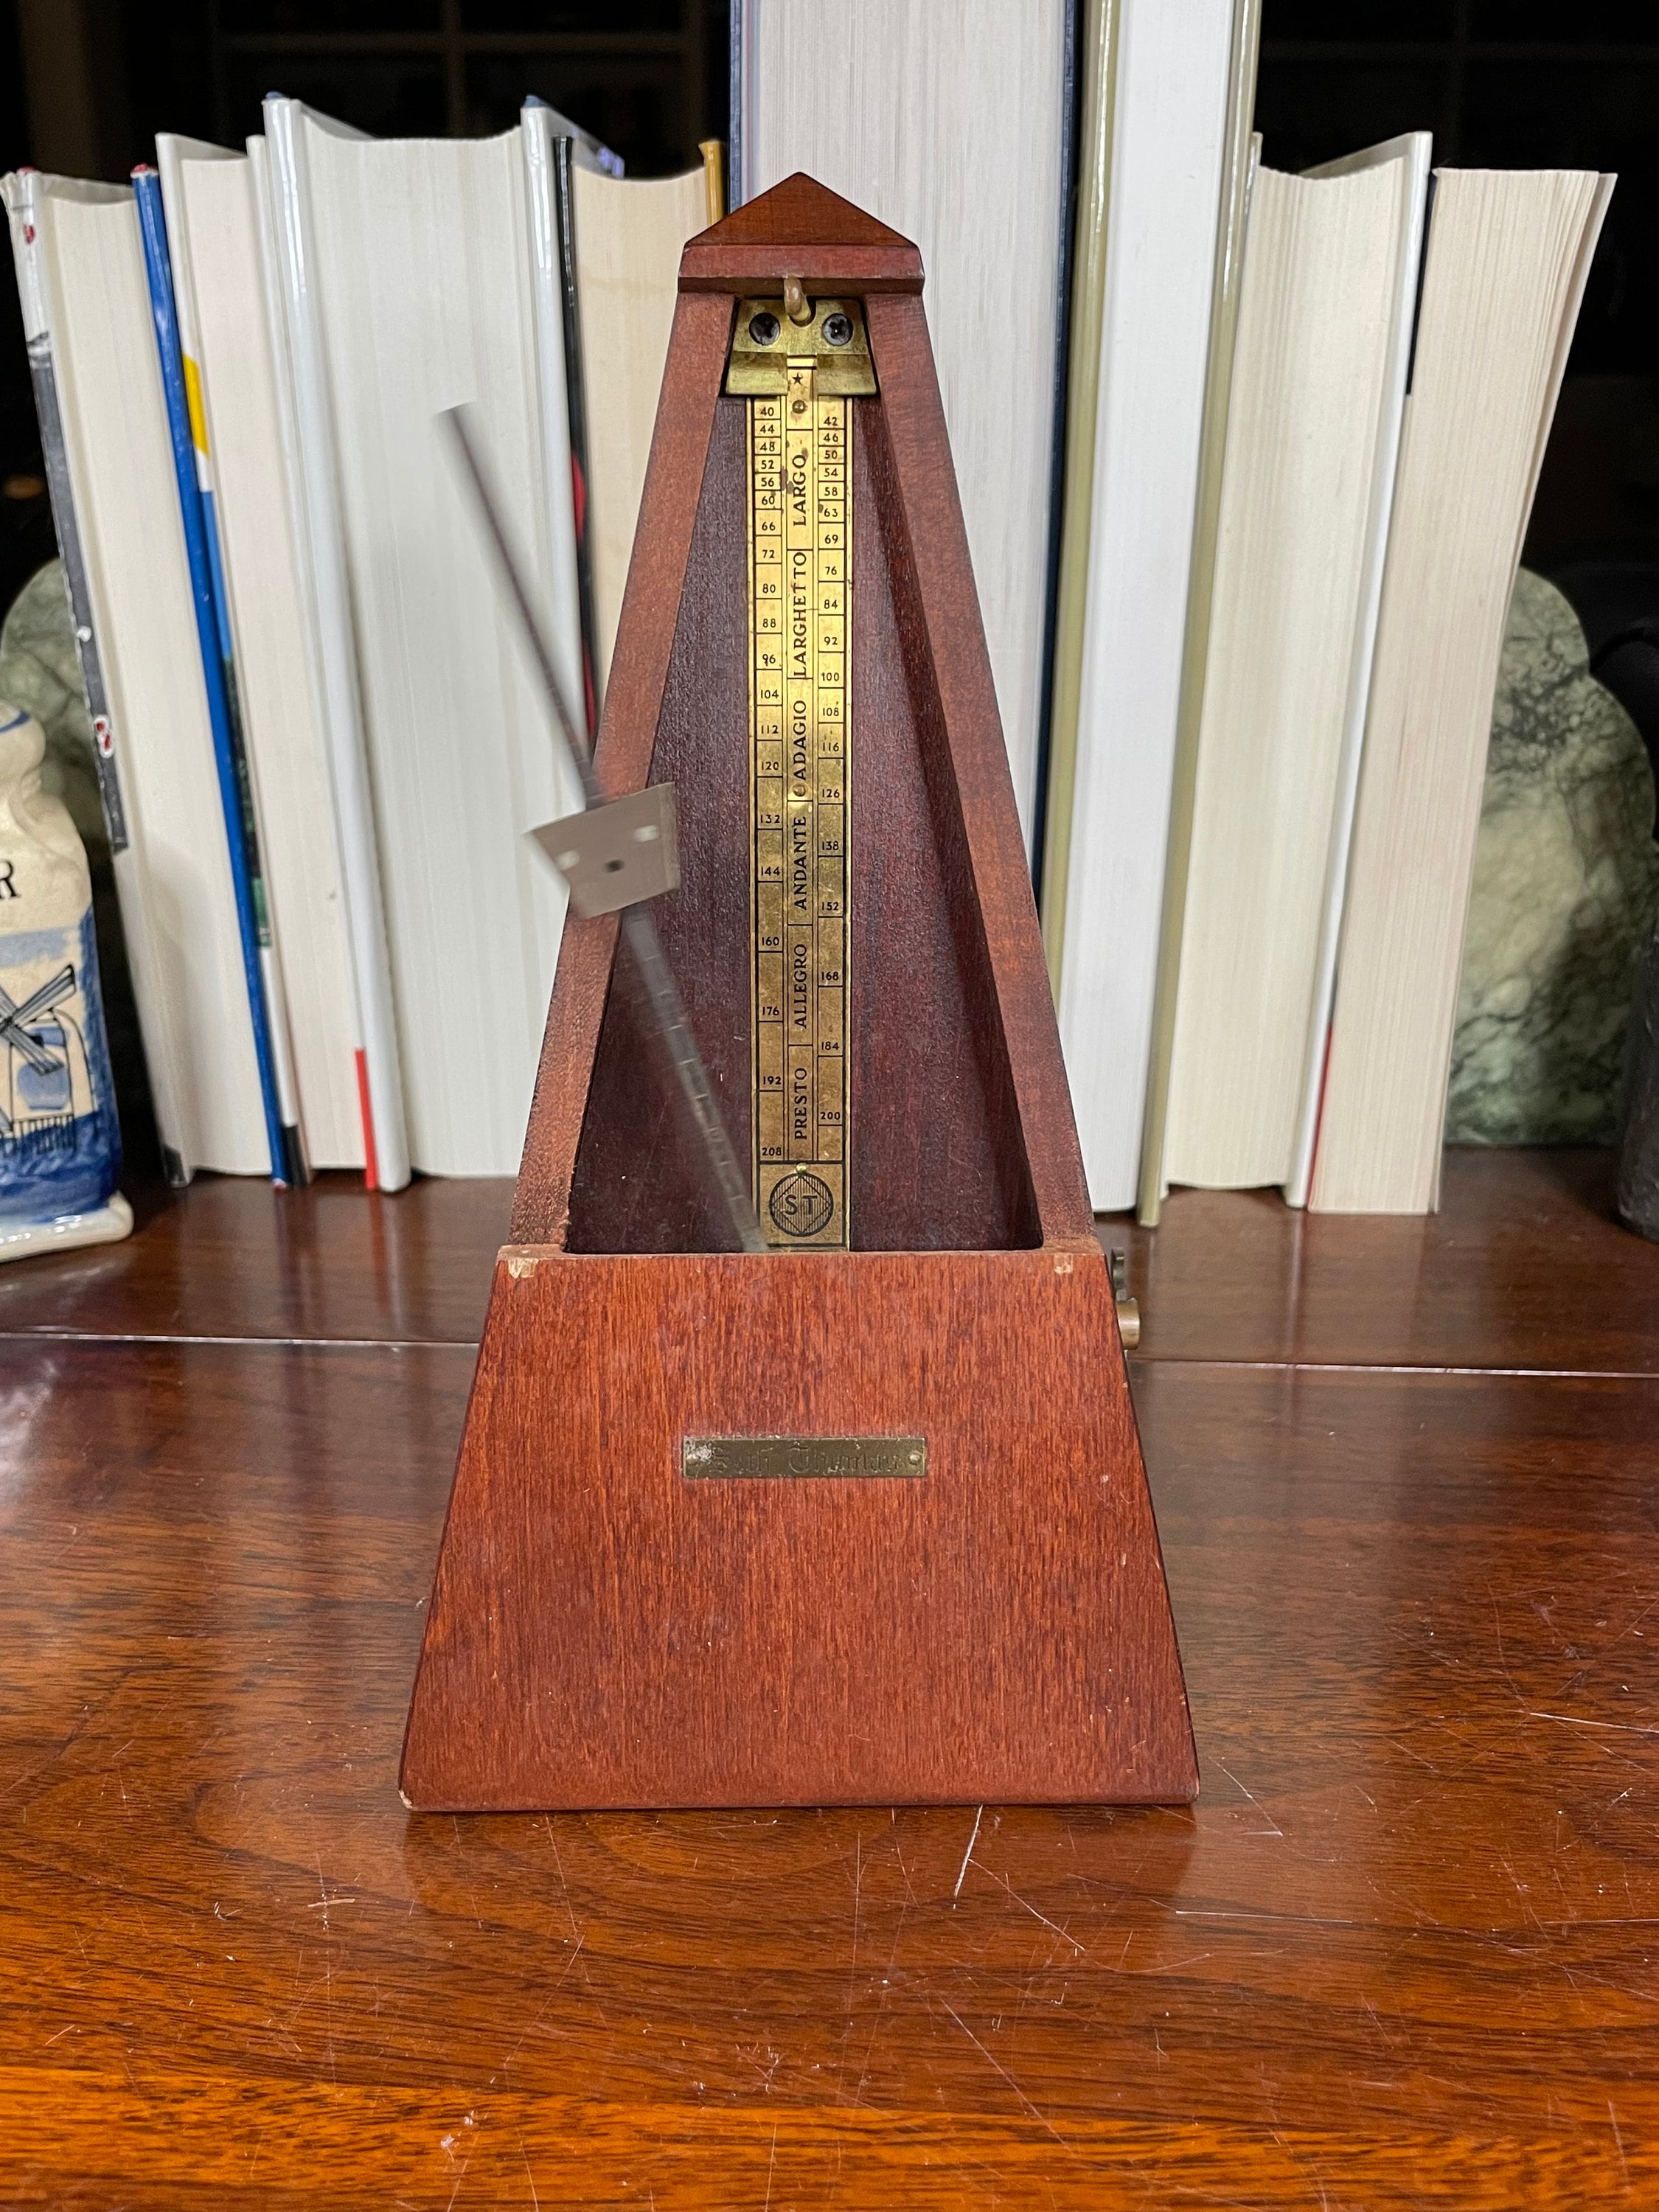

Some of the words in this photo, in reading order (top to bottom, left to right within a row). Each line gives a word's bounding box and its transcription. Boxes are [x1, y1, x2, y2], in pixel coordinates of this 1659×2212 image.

[760, 407, 774, 416] 40
[824, 417, 838, 426] 42
[759, 425, 775, 434] 44
[823, 433, 838, 442] 46
[759, 442, 775, 451] 48
[824, 451, 838, 459] 50
[761, 460, 774, 469] 52
[824, 468, 838, 477] 54
[761, 478, 774, 487] 56
[793, 455, 807, 526] LARGO
[824, 487, 838, 496] 58
[762, 495, 775, 504] 60
[824, 508, 838, 517] 63
[762, 522, 776, 531] 66
[824, 535, 838, 544] 69
[762, 550, 775, 558] 72
[825, 566, 837, 575] 76
[762, 584, 776, 593] 80
[824, 599, 838, 608] 84
[793, 552, 807, 677] LARGHETTO
[762, 619, 776, 627] 88
[824, 636, 838, 645] 92
[762, 654, 776, 664] 96
[821, 672, 839, 681] 100
[760, 689, 779, 698] 104
[822, 708, 839, 716] 108
[761, 726, 778, 734] 112
[793, 700, 806, 780] ADAGIO
[822, 742, 839, 751] 116
[762, 762, 779, 770] 120
[822, 789, 840, 798] 126
[760, 815, 780, 824] 132
[822, 841, 839, 850] 138
[794, 816, 807, 910] ANDANTE
[761, 866, 780, 875] 144
[821, 902, 838, 911] 152
[762, 936, 779, 945] 160
[821, 972, 838, 981] 168
[794, 944, 807, 1029] ALLEGRO
[762, 1006, 779, 1015] 176
[821, 1042, 839, 1050] 184
[762, 1076, 782, 1085] 192
[794, 1068, 807, 1140] PRESTO
[821, 1111, 841, 1120] 200
[762, 1147, 782, 1156] 208
